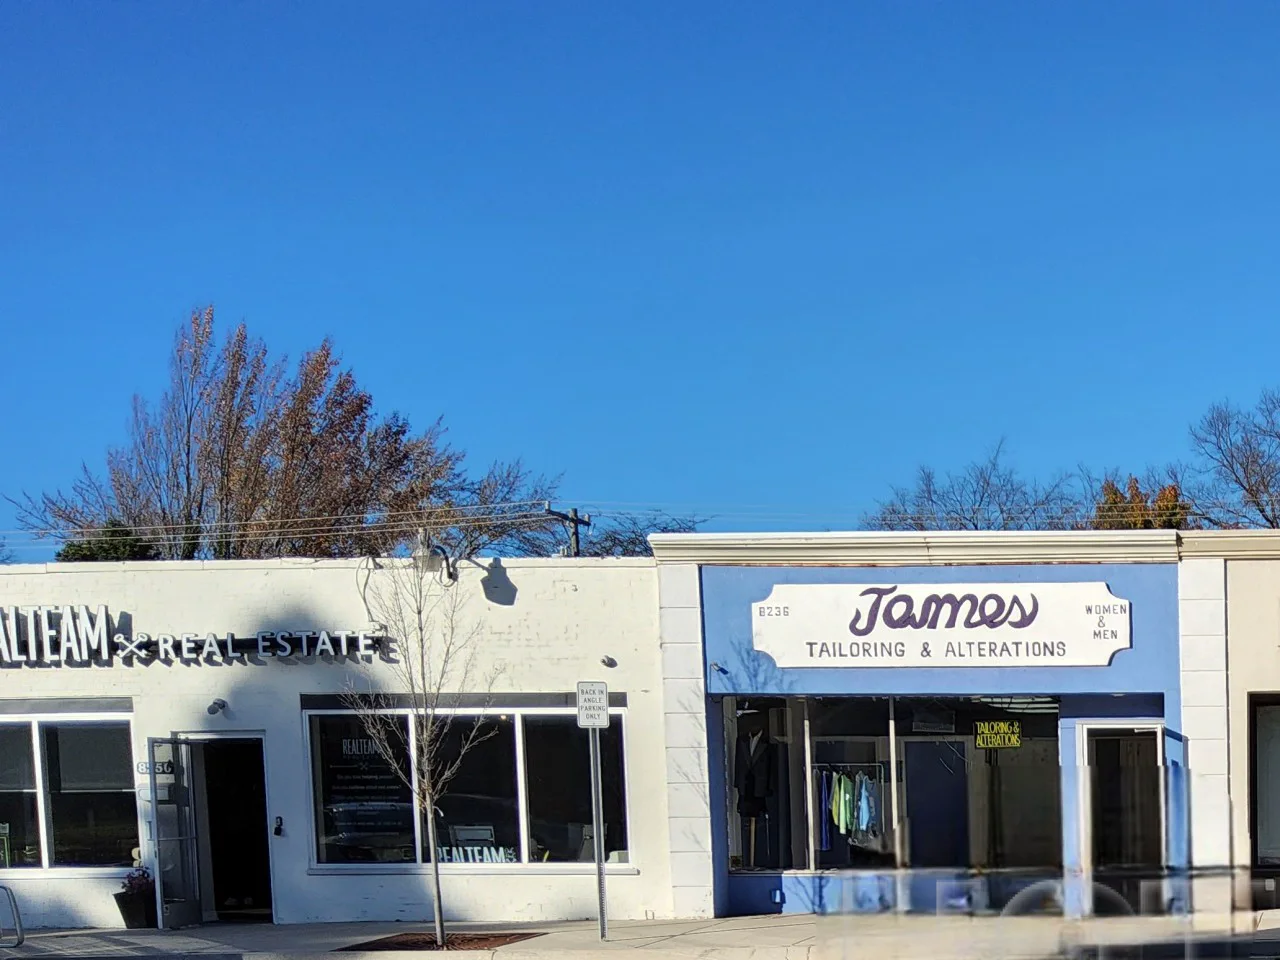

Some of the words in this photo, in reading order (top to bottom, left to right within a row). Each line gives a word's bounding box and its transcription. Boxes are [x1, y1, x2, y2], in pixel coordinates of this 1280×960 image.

[849, 585, 1039, 637] James
[1085, 604, 1127, 615] WOMEN
[1097, 616, 1106, 628] &
[1093, 629, 1118, 640] MEN
[158, 632, 241, 659] REAL
[257, 630, 375, 657] ESTATE
[806, 641, 905, 658] TAILORING
[920, 641, 932, 658] &
[945, 641, 1067, 658] ALTERATIONS
[975, 721, 1012, 734] TAILORING
[976, 733, 1021, 747] ALTERATIONS
[138, 762, 172, 774] 850
